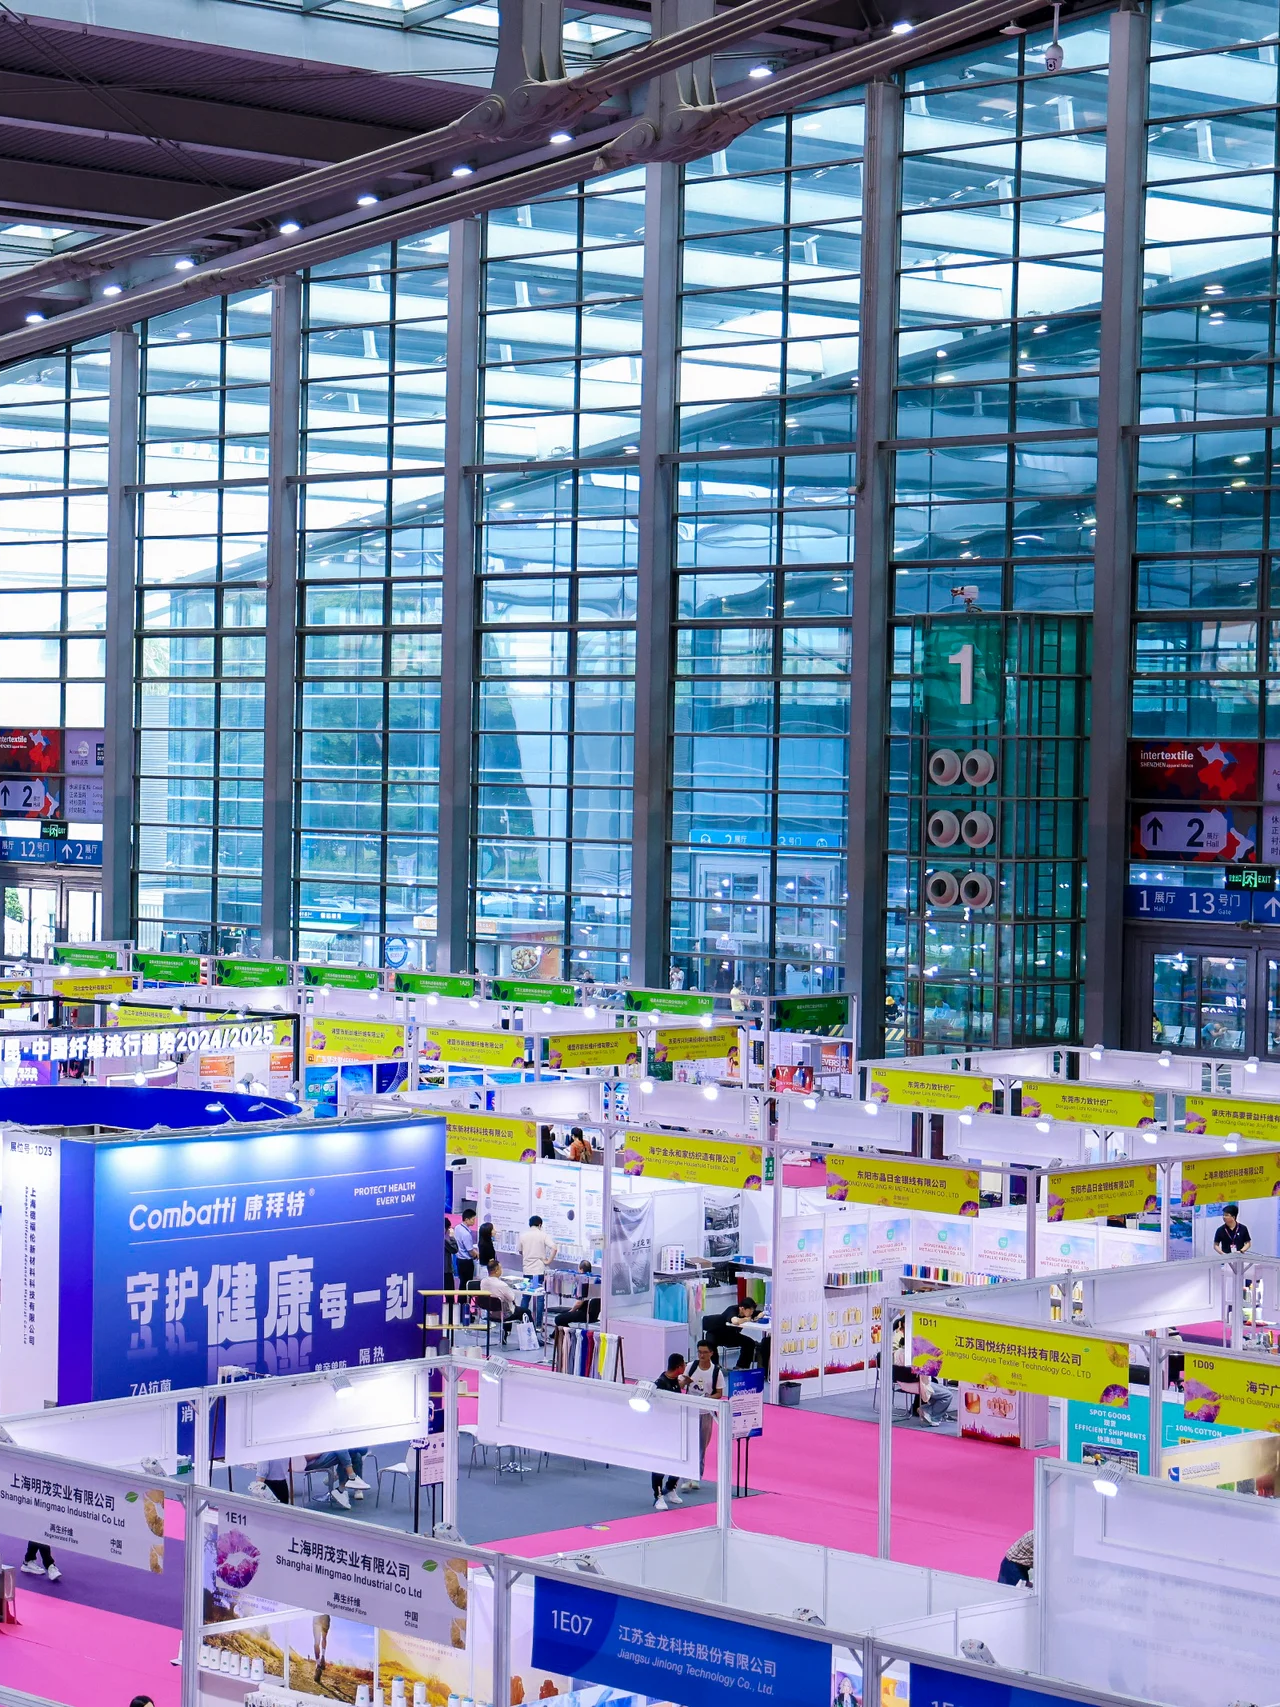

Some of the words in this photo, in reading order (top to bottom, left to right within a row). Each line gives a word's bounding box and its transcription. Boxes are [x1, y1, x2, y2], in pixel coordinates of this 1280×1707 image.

[949, 645, 973, 704] 1
[1140, 750, 1194, 761] intertextile
[22, 785, 33, 808] 2
[1186, 818, 1205, 847] 2
[2, 841, 14, 850] 展厅
[21, 841, 36, 857] 12
[37, 842, 50, 852] 号门
[76, 843, 84, 860] 2
[85, 844, 98, 853] 展厅
[1206, 840, 1219, 848] Hall
[1258, 875, 1271, 884] EXIT
[1139, 890, 1150, 911] 1
[1154, 892, 1176, 904] 展厅
[1189, 891, 1215, 914] 13
[1219, 894, 1241, 907] 号门
[35, 1144, 52, 1157] 1D23
[648, 1146, 737, 1165] 海宁金永和家纺织造有限公司
[831, 1158, 845, 1166] 1C17
[856, 1170, 947, 1190] 东阳市晶日金银线有限公司
[1051, 1177, 1062, 1185] 1C17
[354, 1184, 386, 1197] PROTECT
[388, 1181, 416, 1194] HEALTH
[921, 1188, 936, 1196] YARN
[376, 1196, 398, 1207] EVERY
[400, 1193, 416, 1204] DAY
[129, 1196, 237, 1231] Combatti
[126, 1254, 415, 1347] 守护健康每一刻
[919, 1317, 937, 1328] 1D11
[359, 1346, 385, 1364] 隔热
[954, 1335, 1082, 1367] 江苏国悦纺织科技有限公司
[945, 1349, 970, 1361] Jiangsu
[972, 1354, 996, 1365] Guoyue
[998, 1357, 1019, 1368] Textile
[1021, 1361, 1059, 1375] Technology
[1077, 1369, 1092, 1380] LTD
[1192, 1359, 1215, 1370] 1D09
[130, 1379, 172, 1397] 7A抗菌
[1219, 1393, 1245, 1405] HaiNing
[1089, 1408, 1107, 1418] SPOT
[1108, 1411, 1131, 1421] GOODS
[1074, 1423, 1108, 1434] EFFICIENT
[1109, 1429, 1147, 1441] SHIPMENTS
[1175, 1424, 1194, 1433] 100%
[1194, 1427, 1223, 1438] COTTON
[10, 1473, 115, 1512] 上海明茂实业有限公司
[0, 1489, 33, 1506] Shanghai
[34, 1497, 66, 1514] Mingmao
[67, 1505, 100, 1522] Industrial
[101, 1514, 112, 1525] Co
[113, 1516, 126, 1528] Ltd
[225, 1511, 247, 1526] 1E11
[44, 1531, 67, 1544] Regenerated
[68, 1537, 79, 1545] Fibre
[49, 1523, 74, 1537] 再生纤维
[110, 1538, 123, 1549] 中国
[110, 1547, 123, 1556] China
[287, 1537, 410, 1581] 上海明茂实业有限公司
[275, 1555, 313, 1574] Shanghai
[315, 1563, 352, 1583] Mingmao
[353, 1573, 393, 1592] Industrial
[394, 1583, 407, 1596] Co
[408, 1586, 422, 1599] Ltd
[333, 1592, 361, 1607] 再生纤维
[326, 1600, 353, 1614] Regenerated
[355, 1607, 367, 1616] Fibre
[404, 1609, 419, 1622] 中国
[404, 1620, 418, 1629] China
[551, 1609, 593, 1637] 1E07
[618, 1623, 777, 1679] 江苏金龙科技股份有限公司
[617, 1649, 651, 1666] Jiangsu
[651, 1655, 683, 1676] Jinlong
[685, 1662, 736, 1689] Technology
[737, 1676, 758, 1692] Co.,
[759, 1680, 775, 1697] Ltd.
